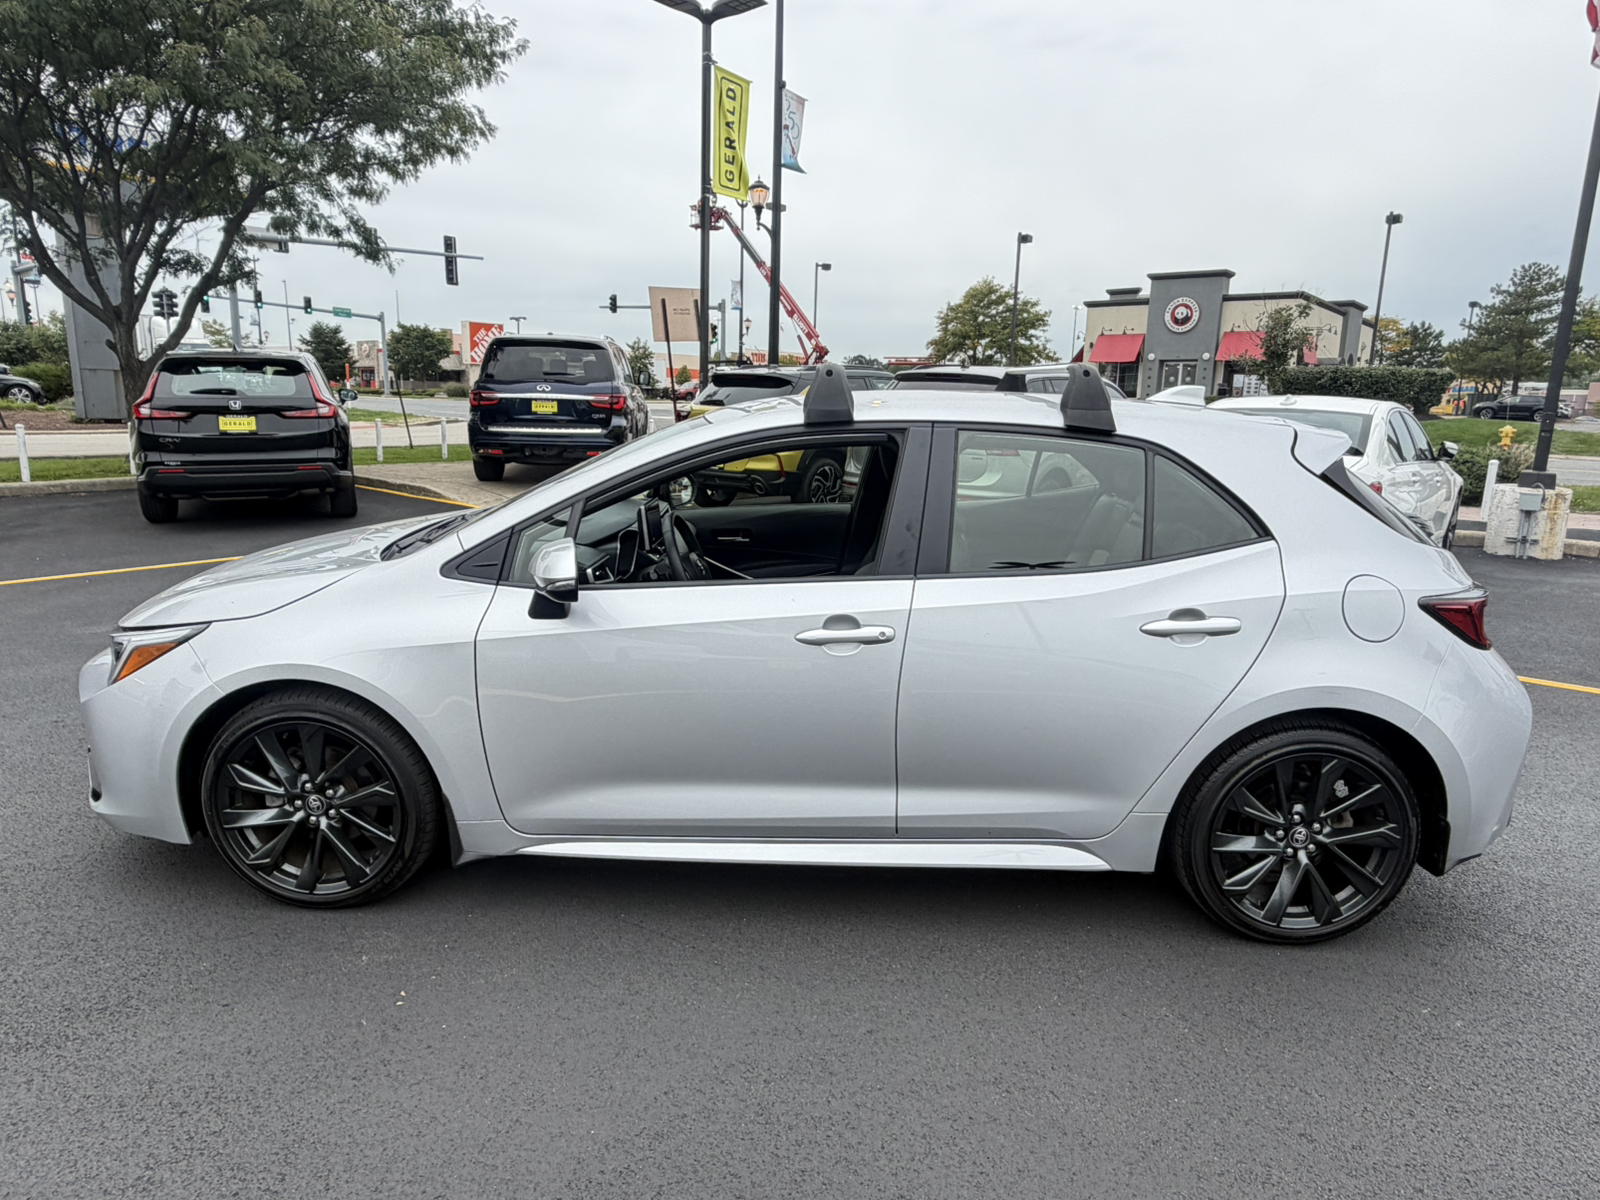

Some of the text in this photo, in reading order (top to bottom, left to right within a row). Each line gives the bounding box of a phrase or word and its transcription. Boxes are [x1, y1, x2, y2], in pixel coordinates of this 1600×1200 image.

[724, 85, 737, 183] GERALD
[1166, 298, 1198, 314] PANDA EXPRESS
[793, 313, 808, 334] ELLIOTT
[470, 324, 504, 363] HOME
[472, 327, 488, 343] THE
